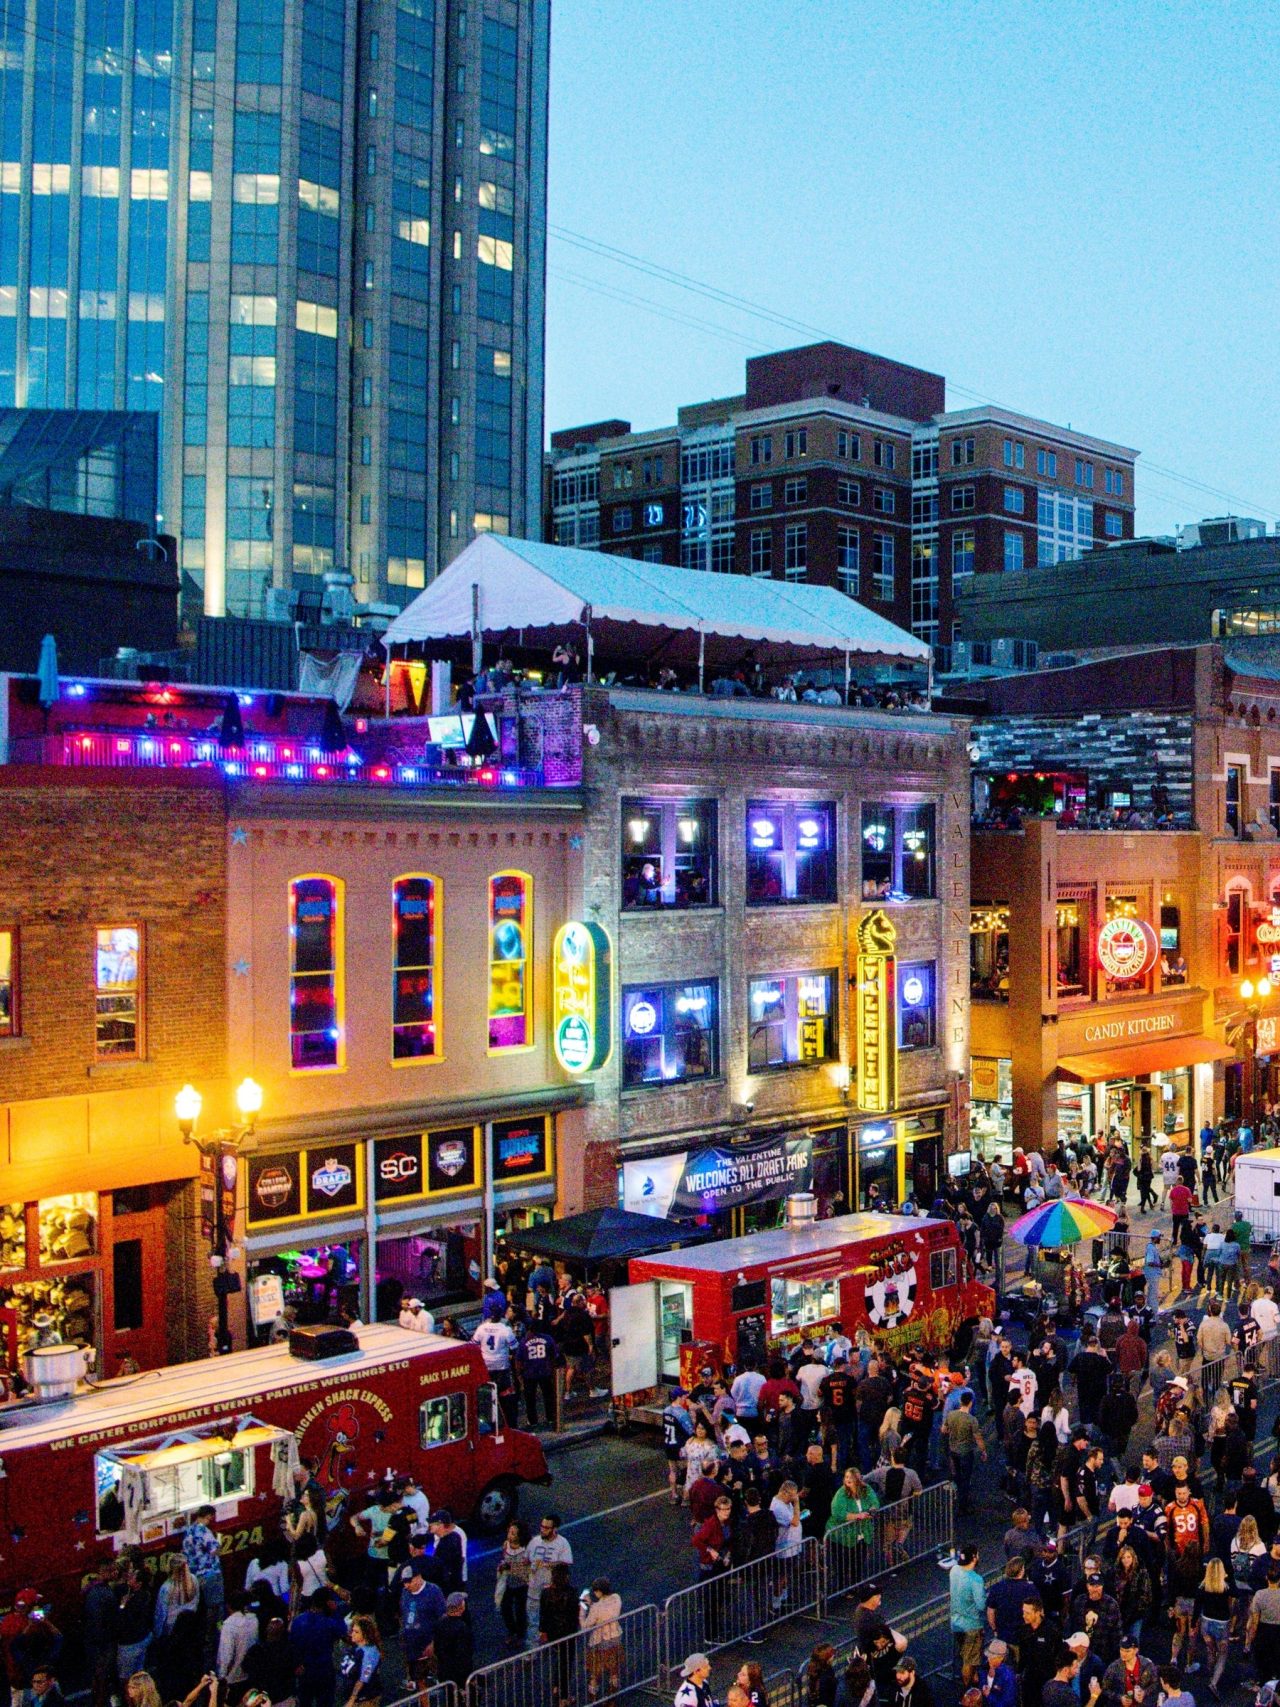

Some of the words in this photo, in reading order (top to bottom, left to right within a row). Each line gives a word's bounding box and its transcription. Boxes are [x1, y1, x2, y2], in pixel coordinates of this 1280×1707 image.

[951, 793, 966, 1044] VALENTINE
[1085, 1022, 1126, 1042] CANDY
[1127, 1014, 1175, 1036] KITCHEN
[380, 1156, 418, 1179] SC
[716, 1159, 735, 1168] THE
[736, 1148, 782, 1164] VALENTINE
[1164, 1161, 1175, 1172] 44
[314, 1174, 350, 1185] DRAFT
[685, 1168, 738, 1193] WELCOMES
[739, 1164, 754, 1183] ALL
[757, 1156, 785, 1179] DRAFT
[786, 1152, 808, 1170] FANS
[703, 1187, 727, 1200] OPEN
[731, 1184, 742, 1193] TO
[745, 1179, 763, 1190] THE
[766, 1172, 795, 1187] PUBLIC
[487, 1335, 496, 1351] 4
[528, 1344, 546, 1360] 28
[50, 1439, 75, 1451] WE
[79, 1427, 125, 1446] CATER
[128, 1407, 212, 1434] CORPORATE
[213, 1395, 263, 1414] EVENTS
[266, 1381, 319, 1401] PARTIES
[321, 1365, 386, 1388] WEDDINGS
[388, 1360, 410, 1371] ETC
[359, 1388, 394, 1424] EXPRESS
[1174, 1515, 1197, 1534] 58
